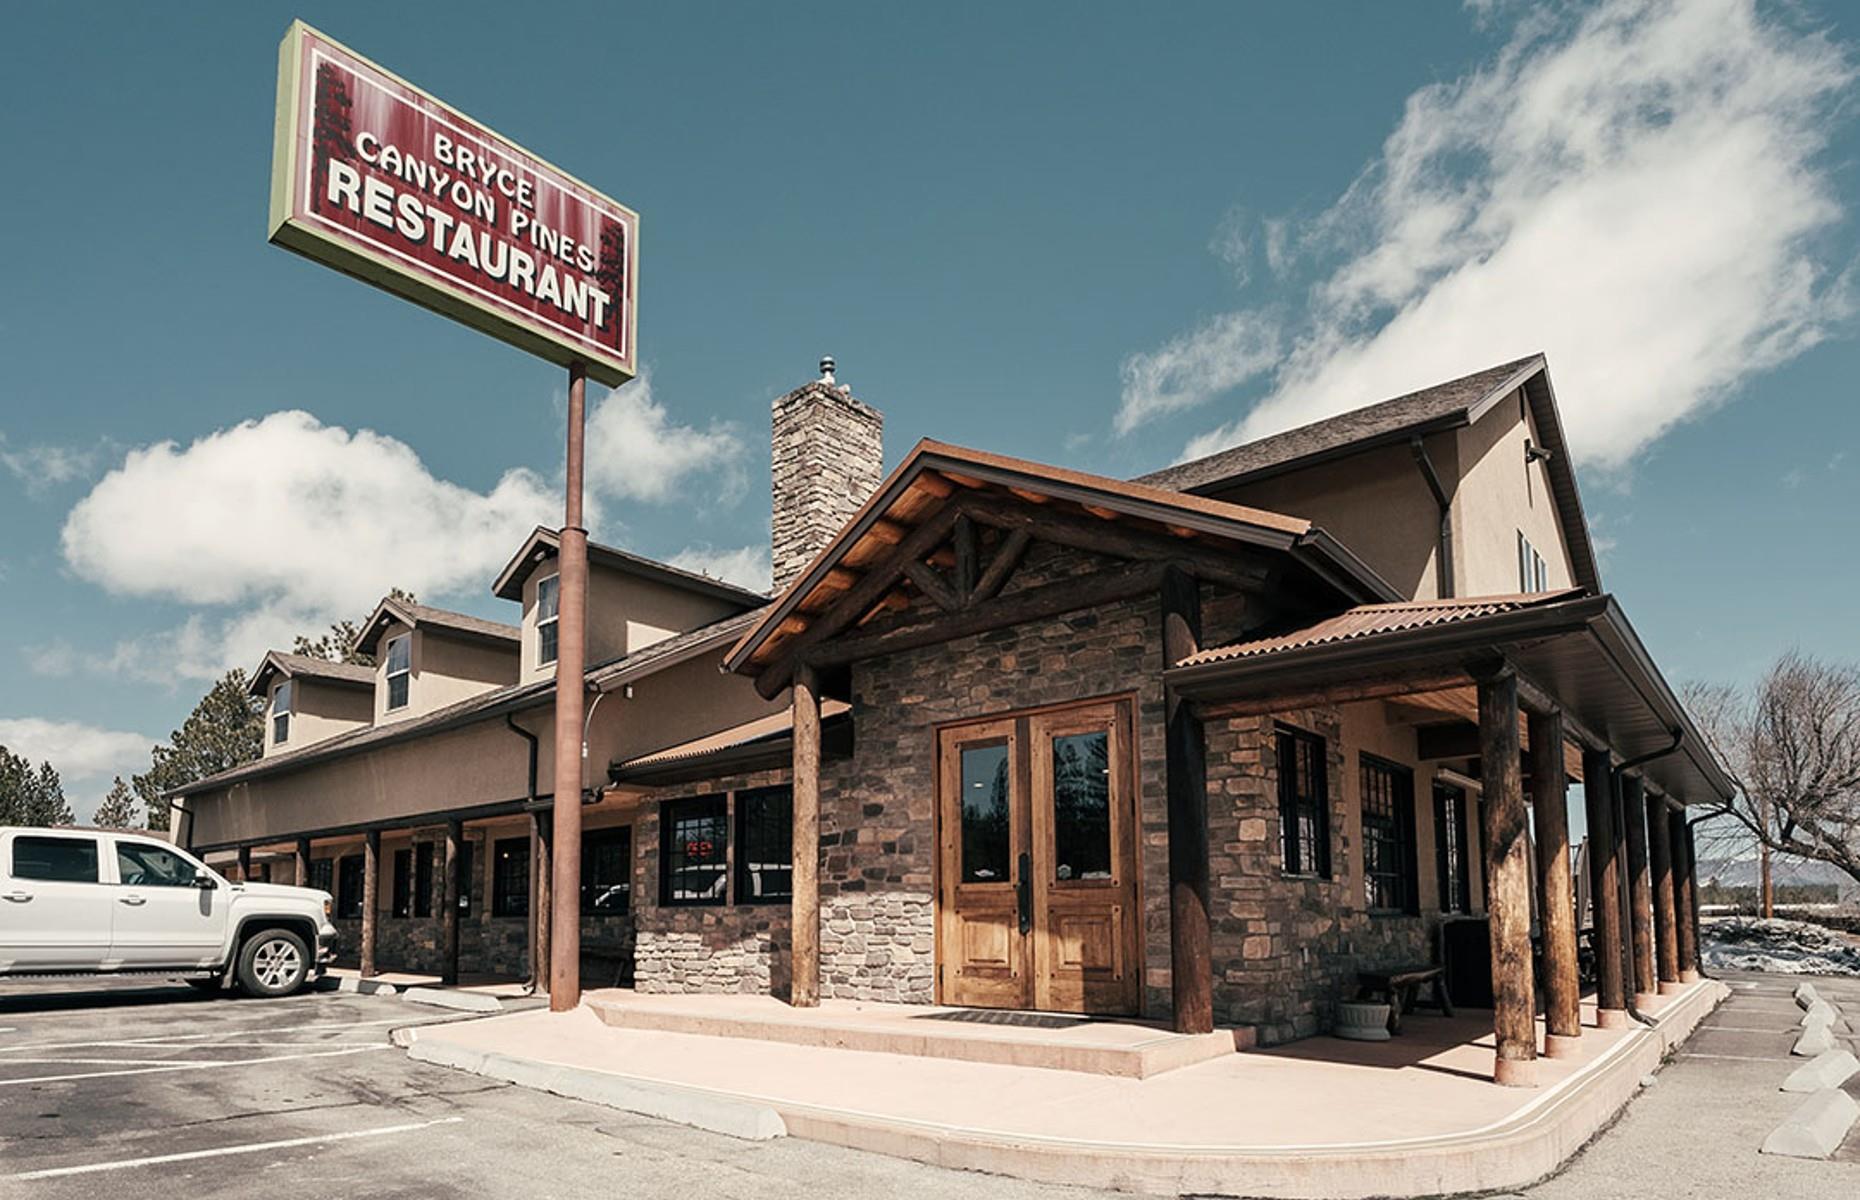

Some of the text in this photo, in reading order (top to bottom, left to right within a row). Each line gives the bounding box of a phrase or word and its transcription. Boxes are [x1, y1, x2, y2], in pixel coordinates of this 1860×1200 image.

[355, 131, 594, 273] CANYON PINES
[434, 132, 534, 207] BRYCE
[328, 158, 610, 327] RESTAURANT
